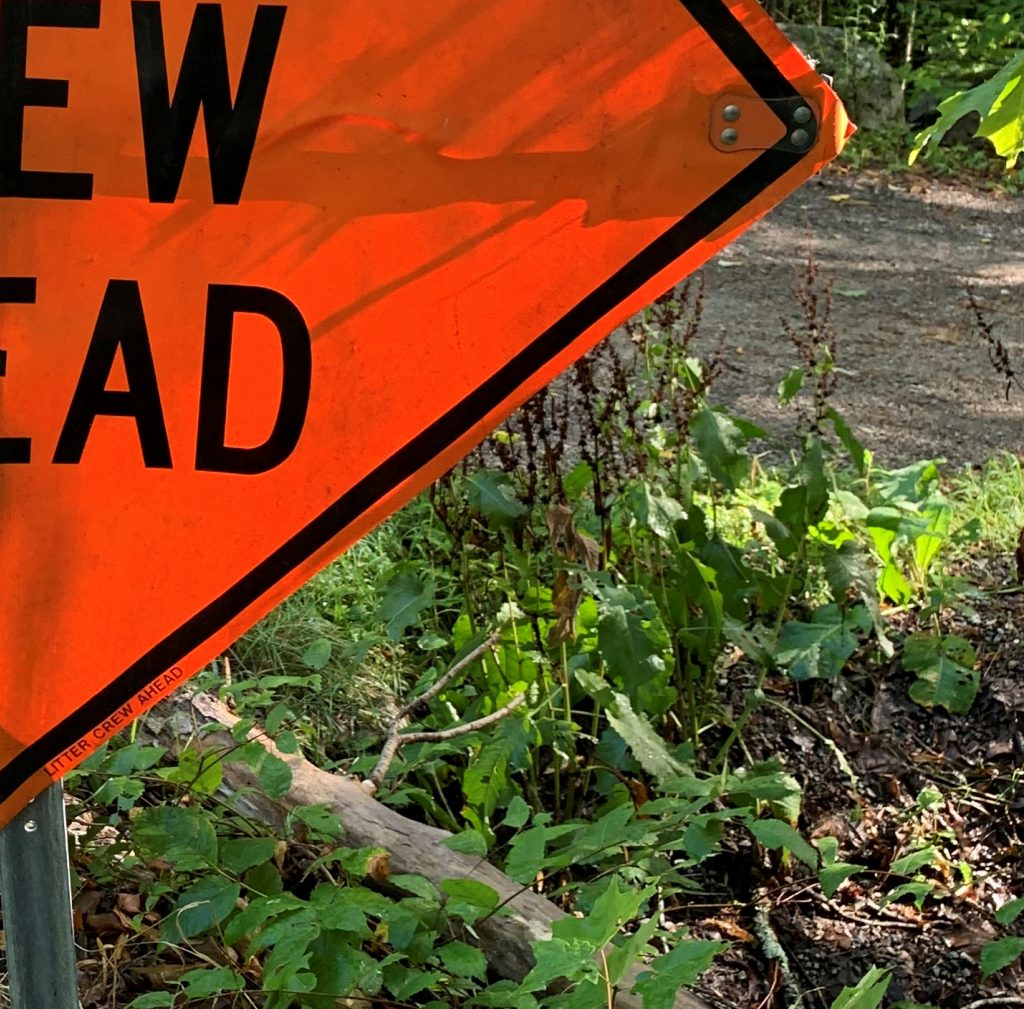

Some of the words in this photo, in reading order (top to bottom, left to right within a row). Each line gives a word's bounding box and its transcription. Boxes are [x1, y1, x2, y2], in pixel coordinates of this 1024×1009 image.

[42, 739, 92, 777] LITTER
[92, 704, 134, 740] CREW
[137, 666, 184, 705] AHEAD
